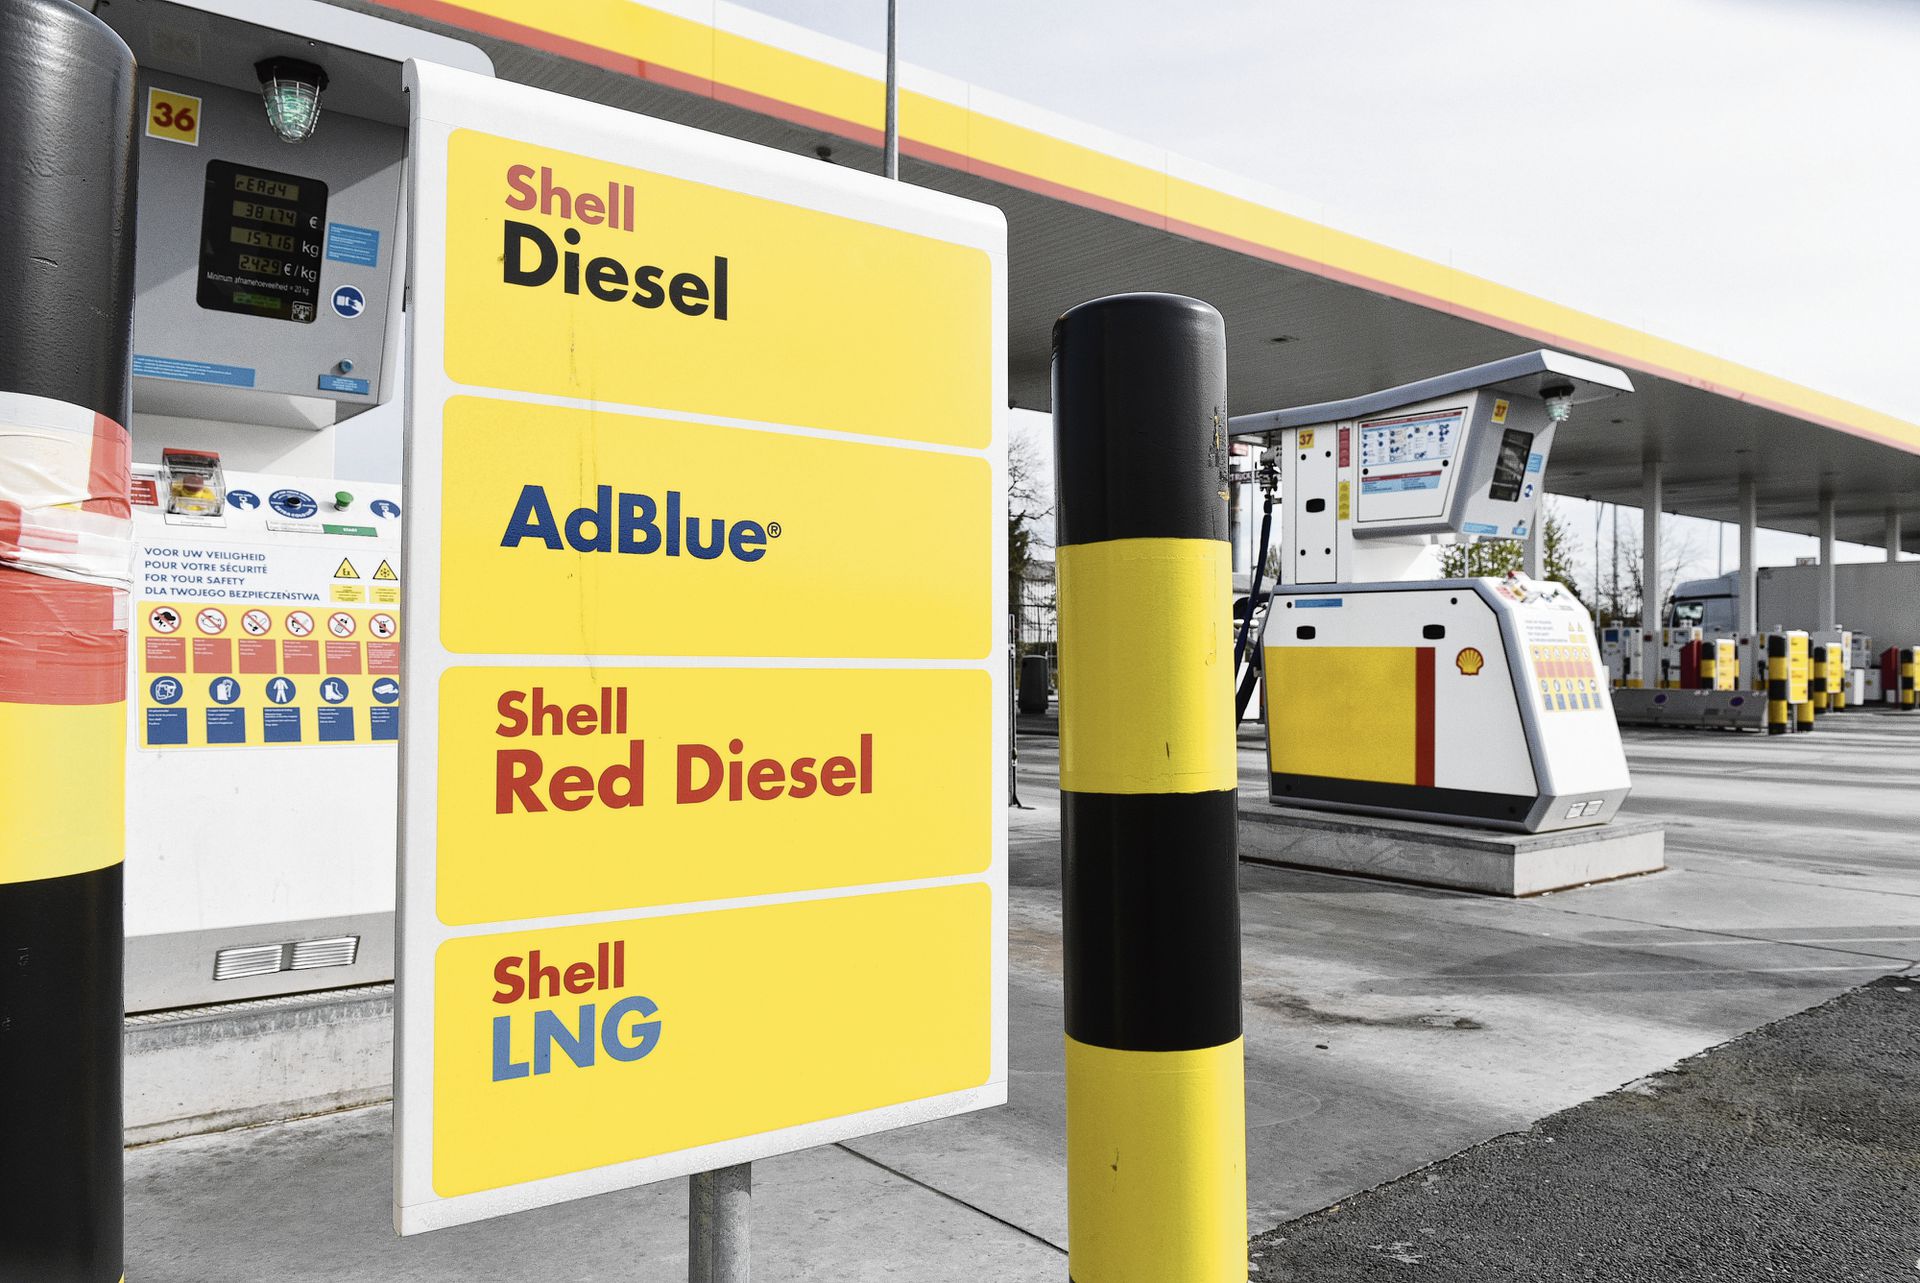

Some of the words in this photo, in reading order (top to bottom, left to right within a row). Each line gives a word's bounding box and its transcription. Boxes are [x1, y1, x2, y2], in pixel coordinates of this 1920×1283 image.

[153, 101, 195, 132] 36
[505, 164, 635, 233] Shell
[302, 240, 319, 258] kg
[503, 219, 728, 321] Diesel
[1494, 405, 1506, 418] 37
[1298, 434, 1313, 446] 37
[144, 547, 179, 557] VOOR
[182, 549, 203, 558] UW
[206, 550, 266, 561] VEILIGHEID
[144, 560, 178, 570] POUR
[181, 562, 217, 572] VOTRE
[220, 562, 268, 574] SÉCURITÉ
[145, 573, 168, 582] FOR
[171, 574, 203, 584] YOUR
[206, 575, 246, 586] SAFETY
[145, 586, 167, 596] DLA
[170, 587, 226, 598] TWOJEGO
[495, 686, 628, 738] Shell
[495, 739, 644, 815] Red
[676, 733, 873, 805] Diesel
[492, 940, 625, 1005] Shell
[492, 995, 662, 1083] LNG
